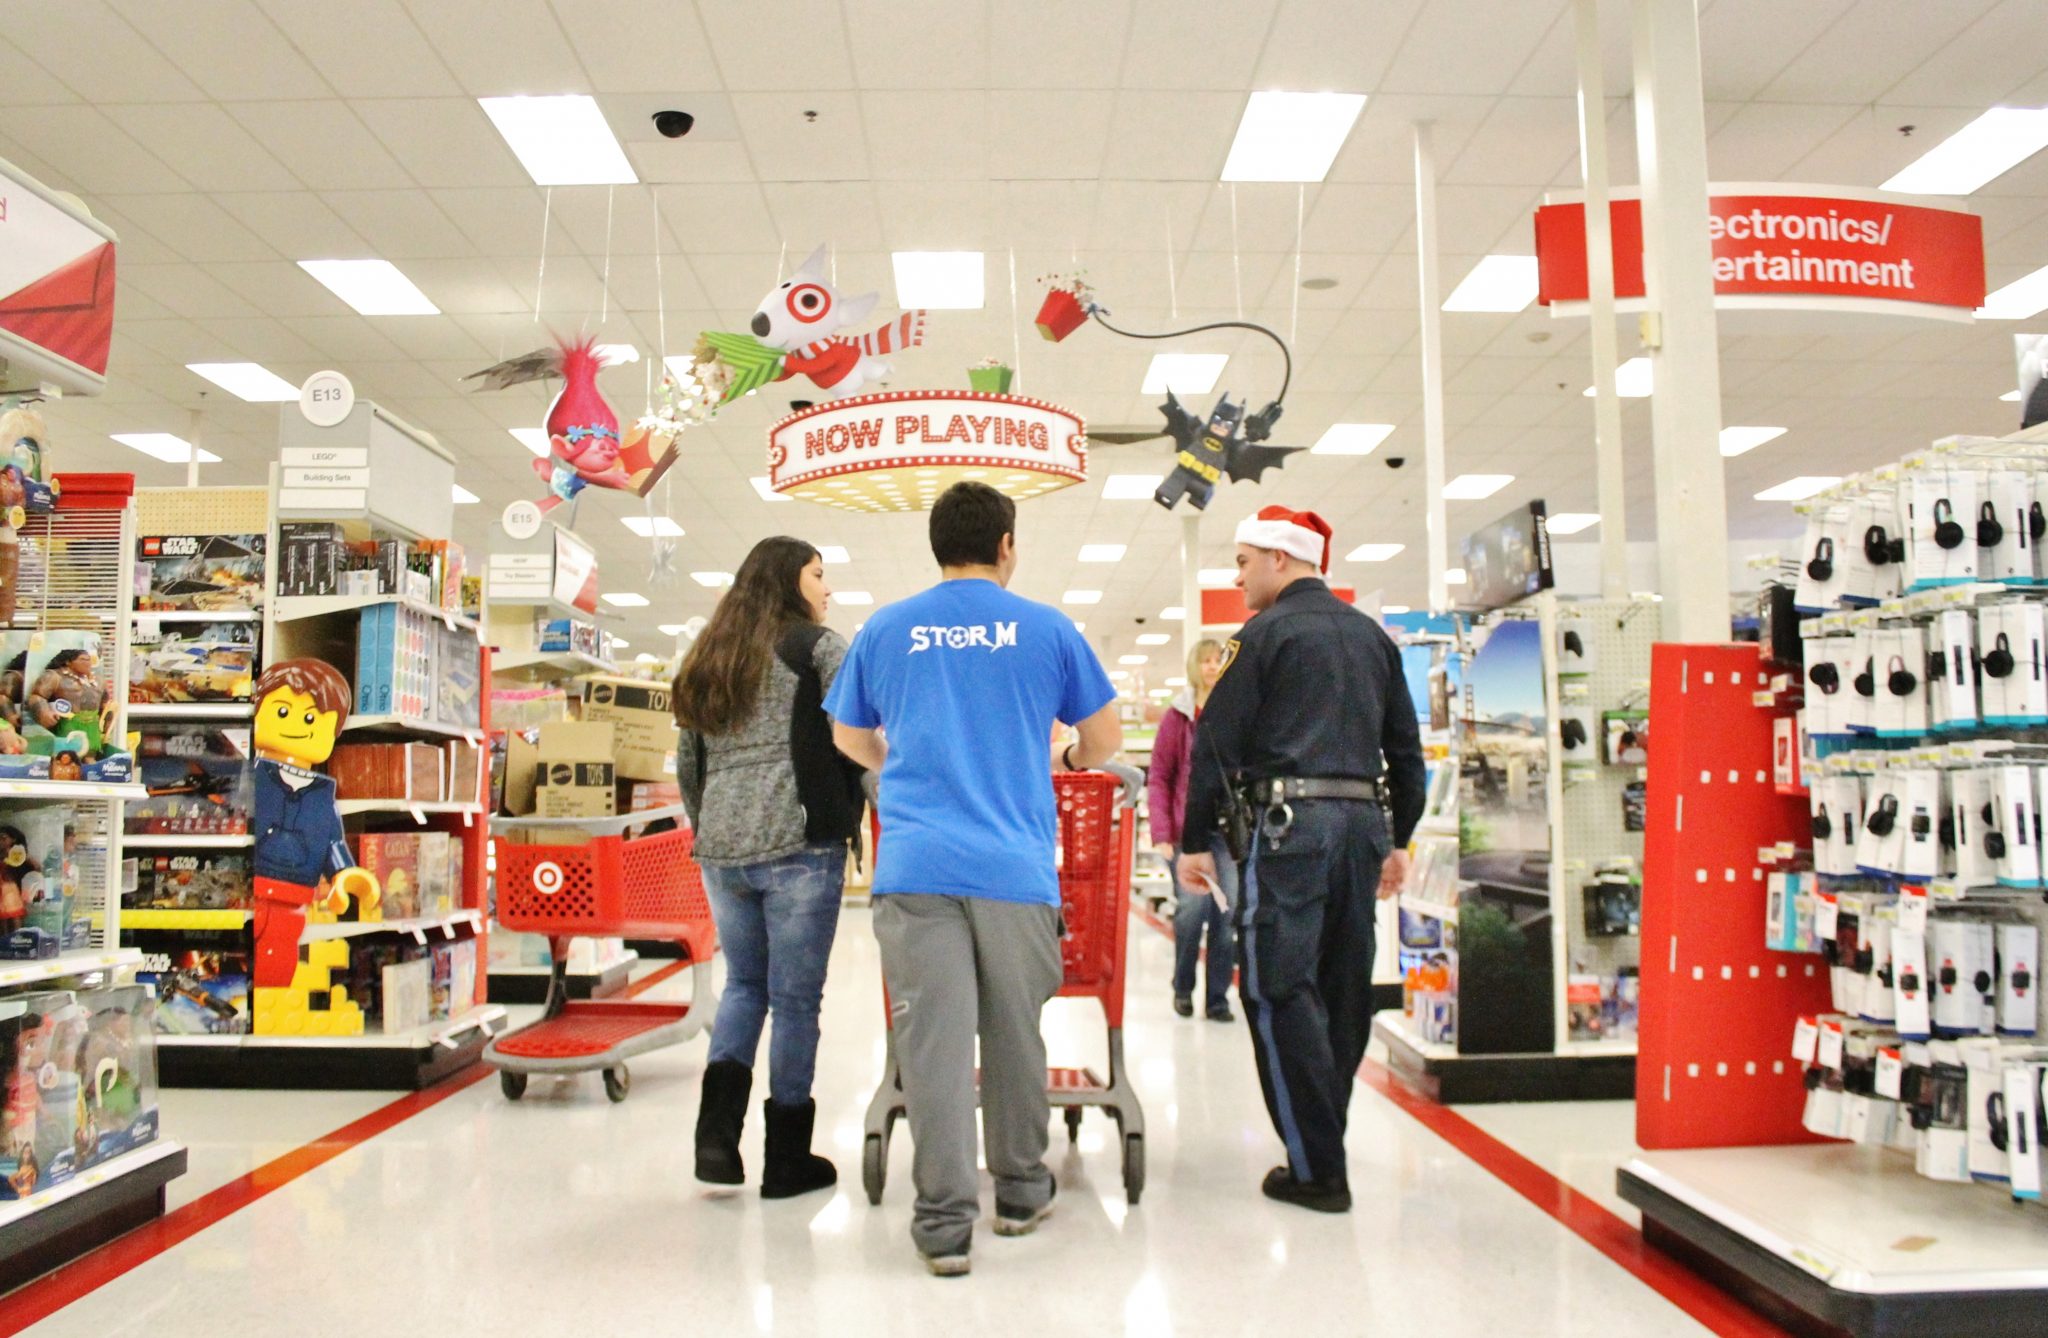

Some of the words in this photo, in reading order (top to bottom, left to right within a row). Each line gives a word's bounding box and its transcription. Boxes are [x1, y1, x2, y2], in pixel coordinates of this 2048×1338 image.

[1709, 208, 1893, 246] ectronics/
[1713, 248, 1915, 289] ertainment
[312, 388, 342, 402] E13
[804, 417, 883, 459] NOW
[895, 414, 1049, 451] PLAYING
[303, 473, 333, 483] Building
[334, 473, 351, 482] Sets
[511, 513, 532, 524] E15
[906, 621, 1019, 655] STORM
[647, 690, 673, 713] TOY
[586, 764, 604, 785] TOYS
